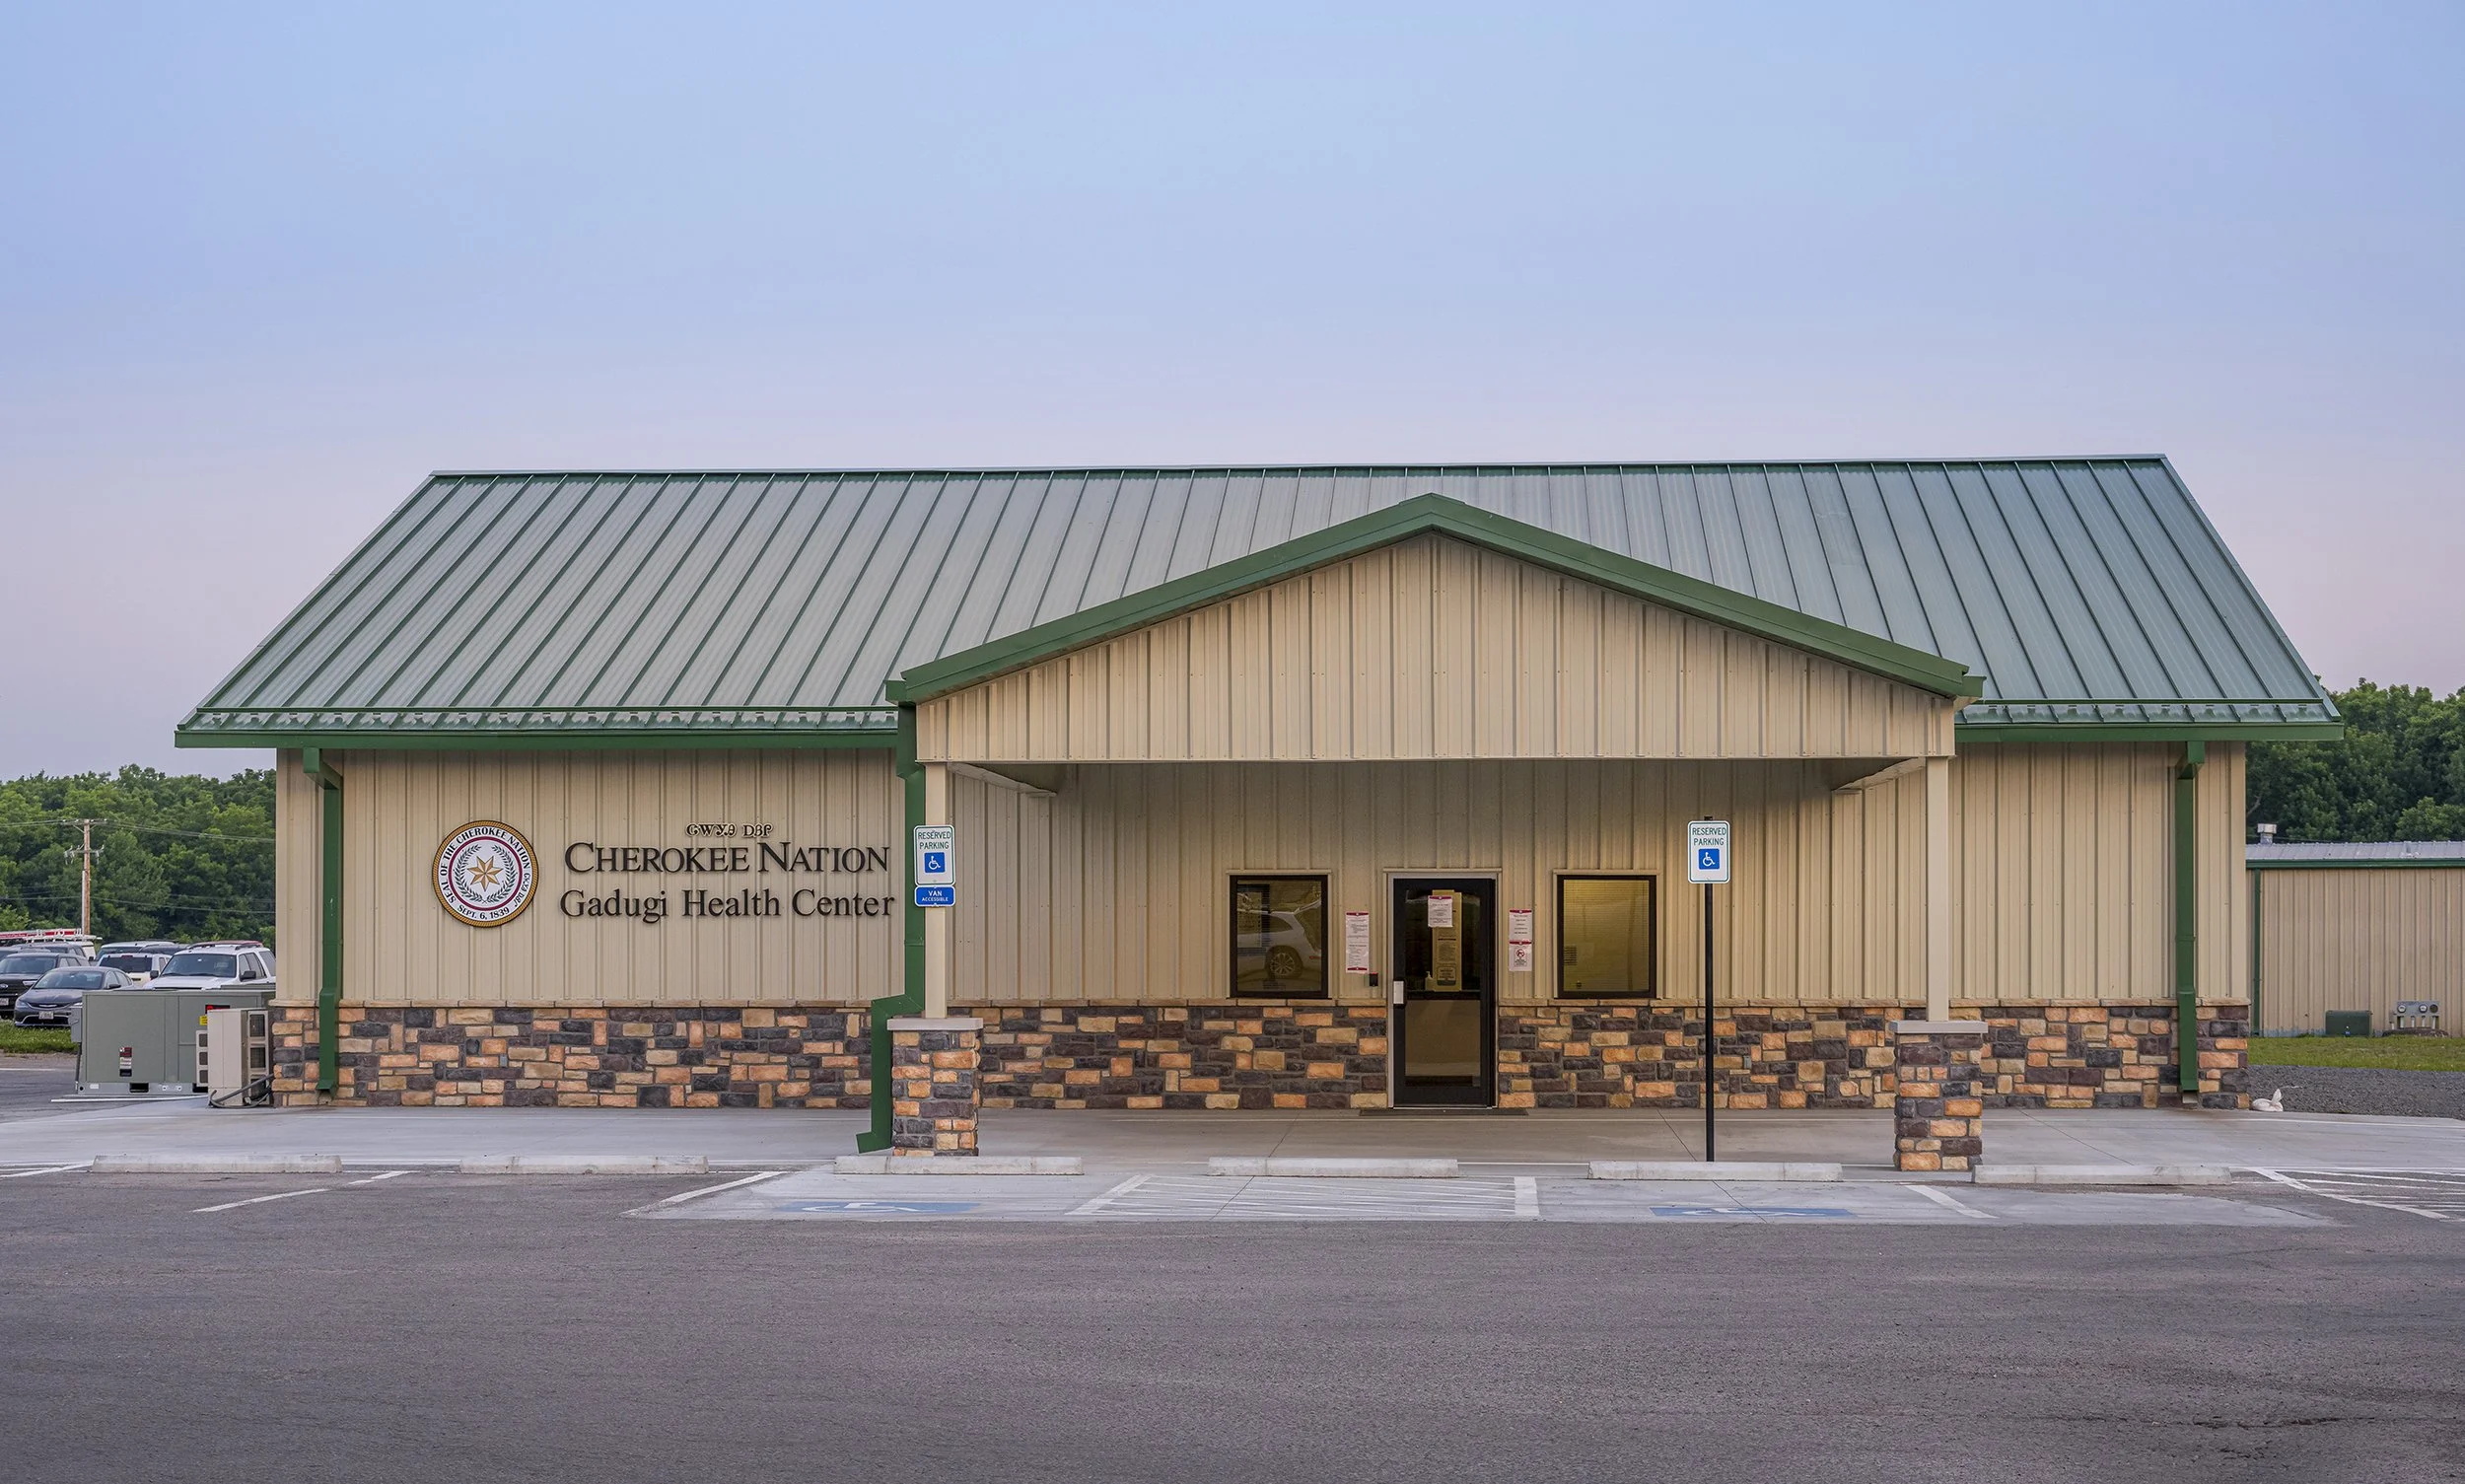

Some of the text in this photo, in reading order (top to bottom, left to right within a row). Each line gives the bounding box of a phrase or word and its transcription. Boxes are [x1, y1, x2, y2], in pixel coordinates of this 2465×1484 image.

[918, 831, 951, 840] RESERVED
[1692, 827, 1726, 836] RESERVED
[919, 841, 950, 850] PARKING
[1693, 837, 1725, 846] PARKING
[564, 841, 890, 873] CHEROKEE NATION
[440, 827, 530, 903] SEAL OF THE CHEROKEE NATION
[457, 904, 477, 919] SEPT.
[490, 907, 510, 919] 1839
[560, 888, 895, 924] Gadugi Health Center
